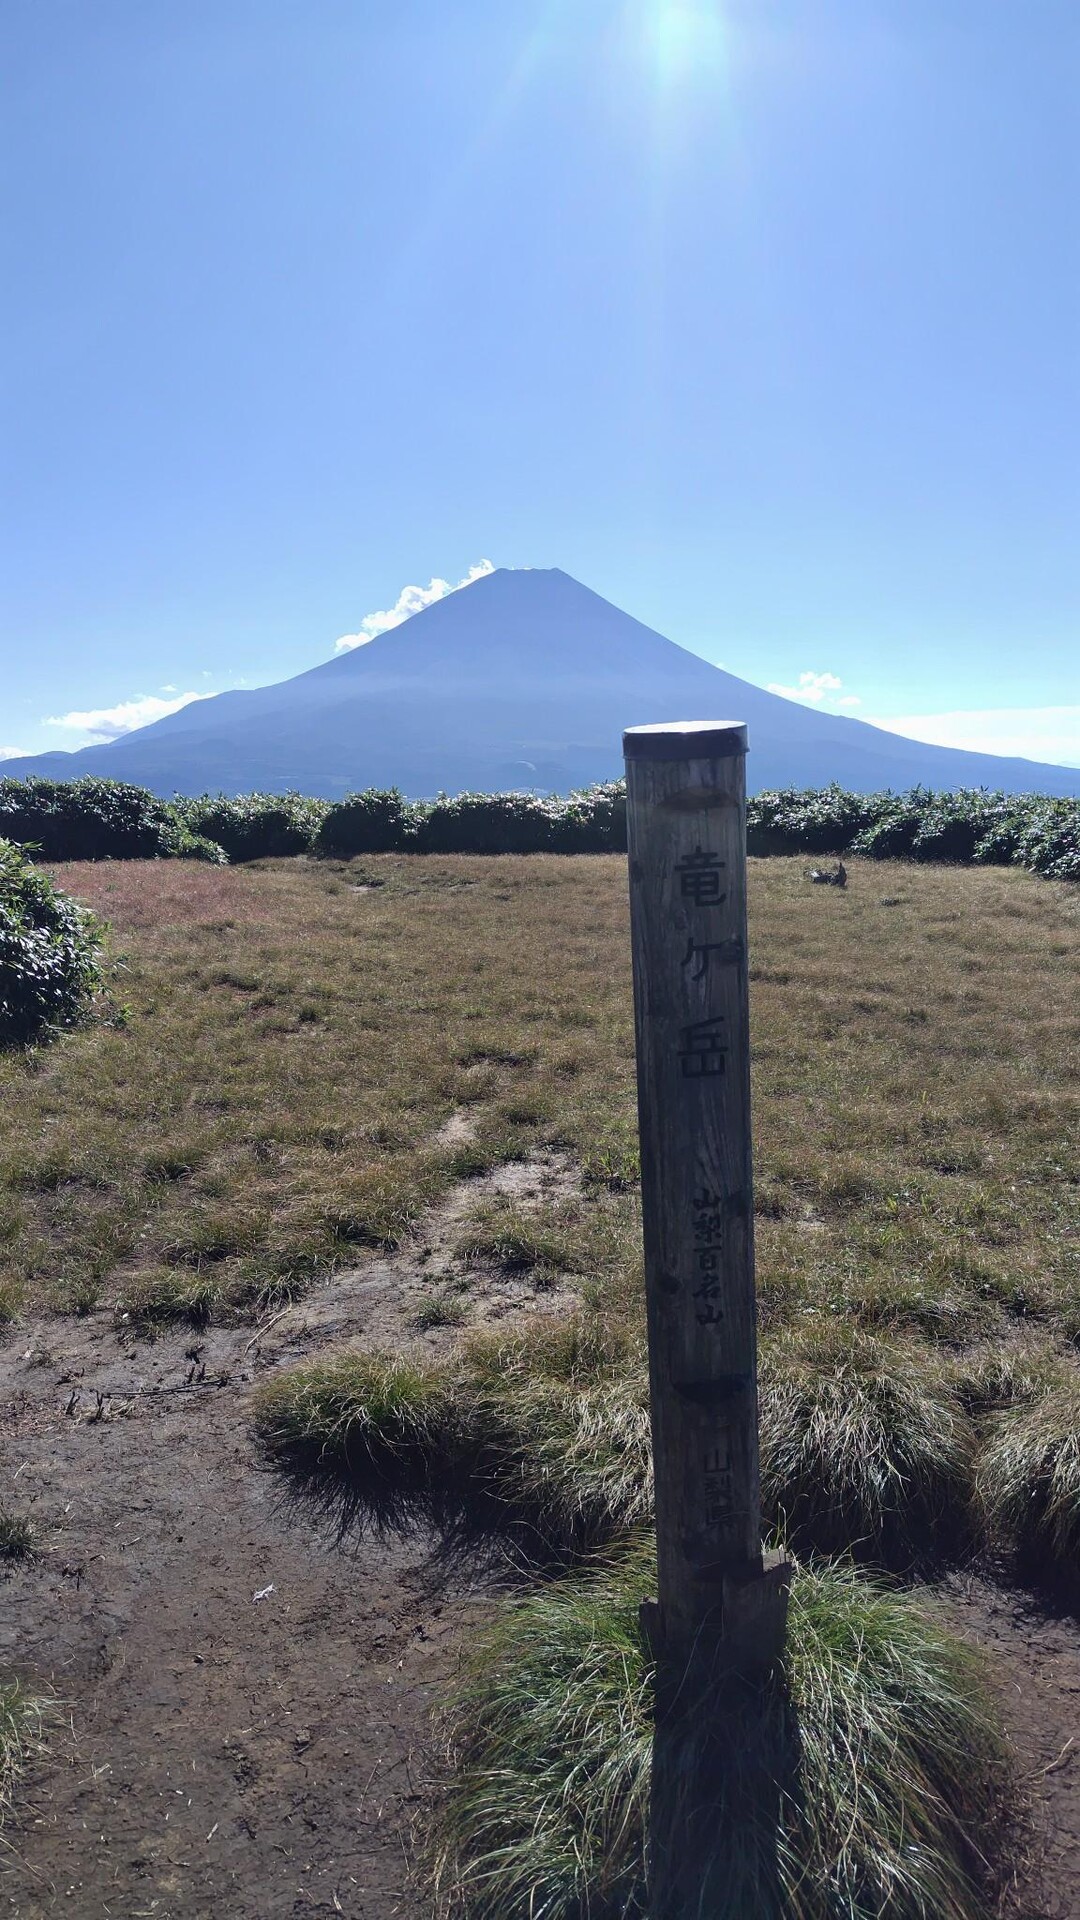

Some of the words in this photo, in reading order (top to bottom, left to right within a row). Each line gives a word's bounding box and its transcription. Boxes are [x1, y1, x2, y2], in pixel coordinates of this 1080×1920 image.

[692, 1187, 724, 1326] 山梨百名山
[703, 1448, 733, 1537] 山梨県
